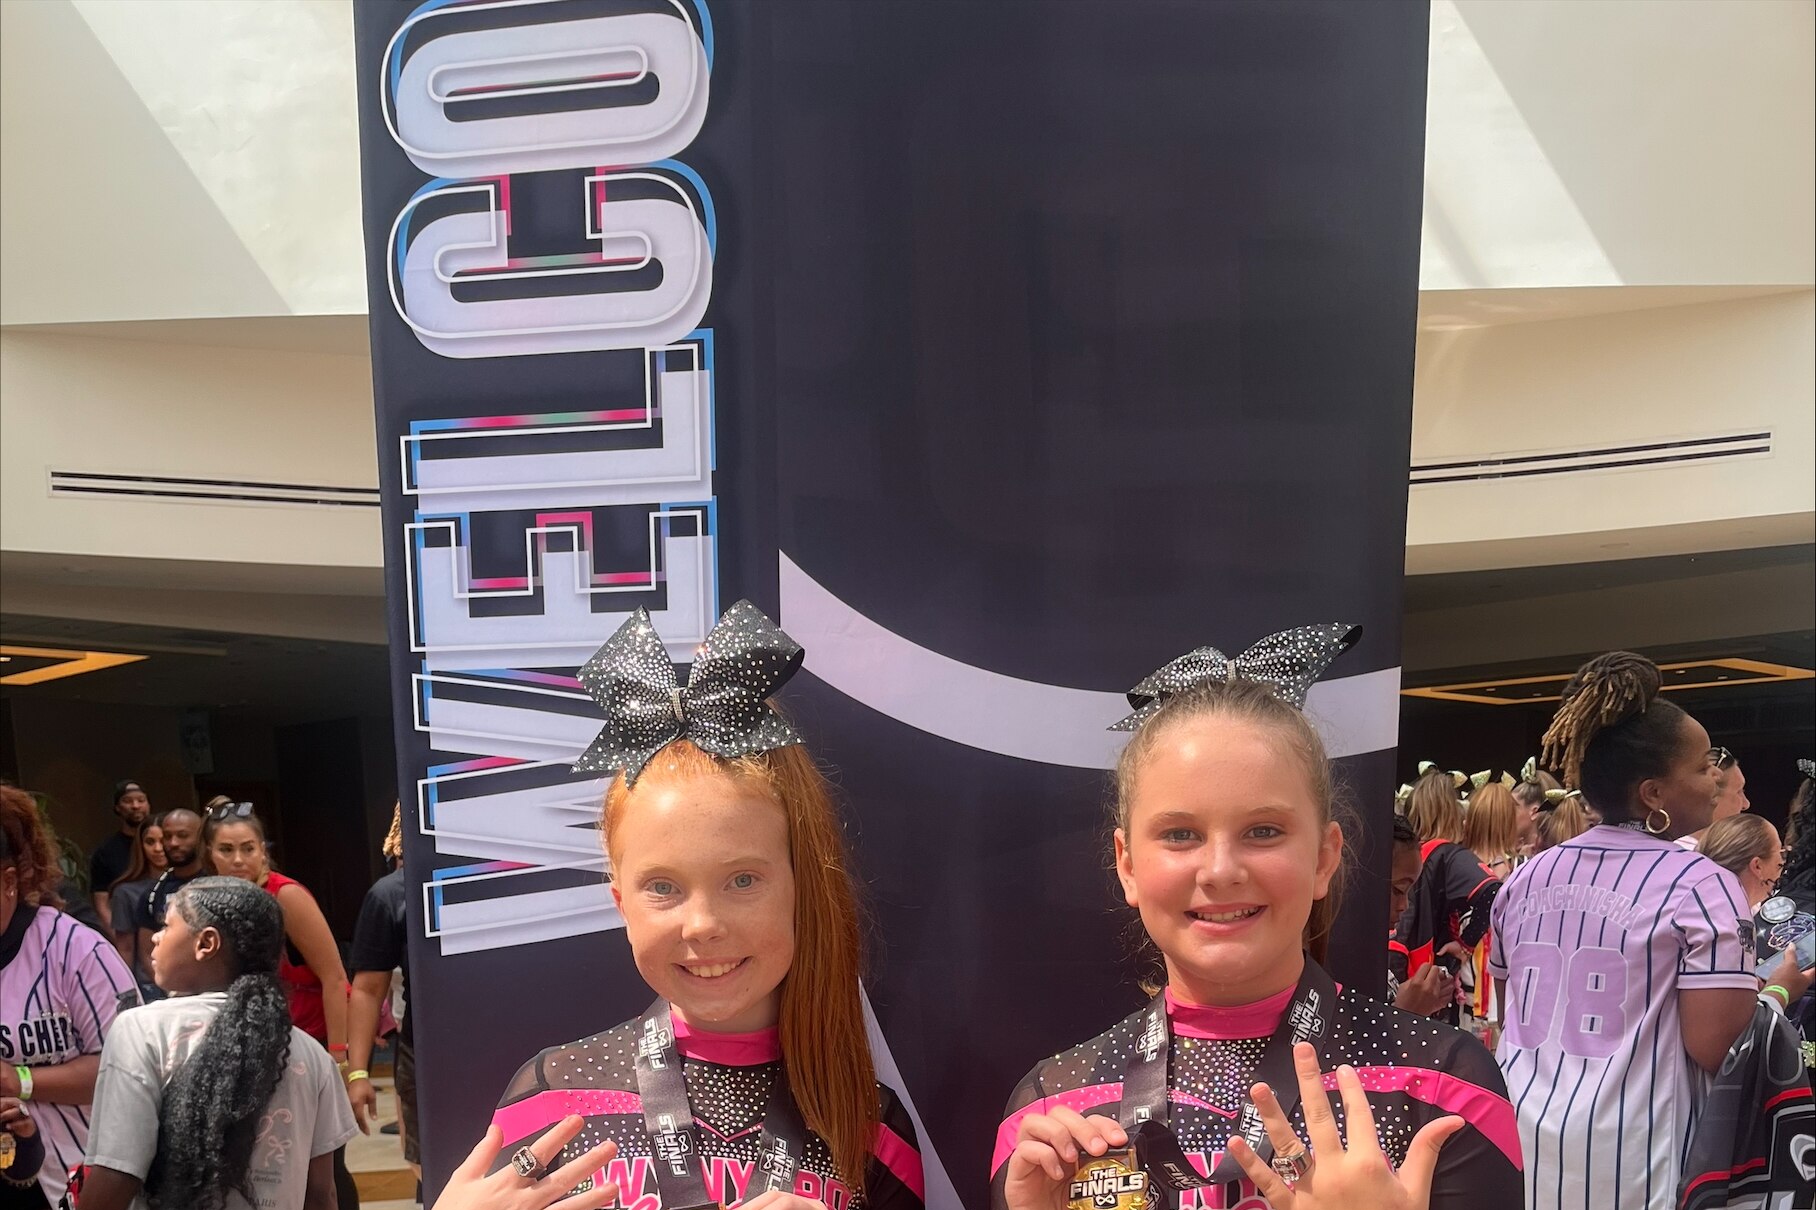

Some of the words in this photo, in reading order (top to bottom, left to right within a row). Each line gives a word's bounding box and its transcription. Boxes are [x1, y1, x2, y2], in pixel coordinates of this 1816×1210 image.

[1618, 822, 1649, 832] FINAL
[1517, 884, 1581, 923] COACH
[1578, 885, 1647, 931] NISHA
[1506, 942, 1628, 1059] 08
[1291, 1002, 1304, 1024] THE
[645, 1018, 665, 1069] FINALS
[1241, 1103, 1254, 1129] THE
[656, 1136, 668, 1158] THE
[659, 1115, 686, 1176] FINALS
[783, 1159, 793, 1179] THE
[1092, 1168, 1116, 1180] THE
[1070, 1174, 1144, 1198] FINALS
